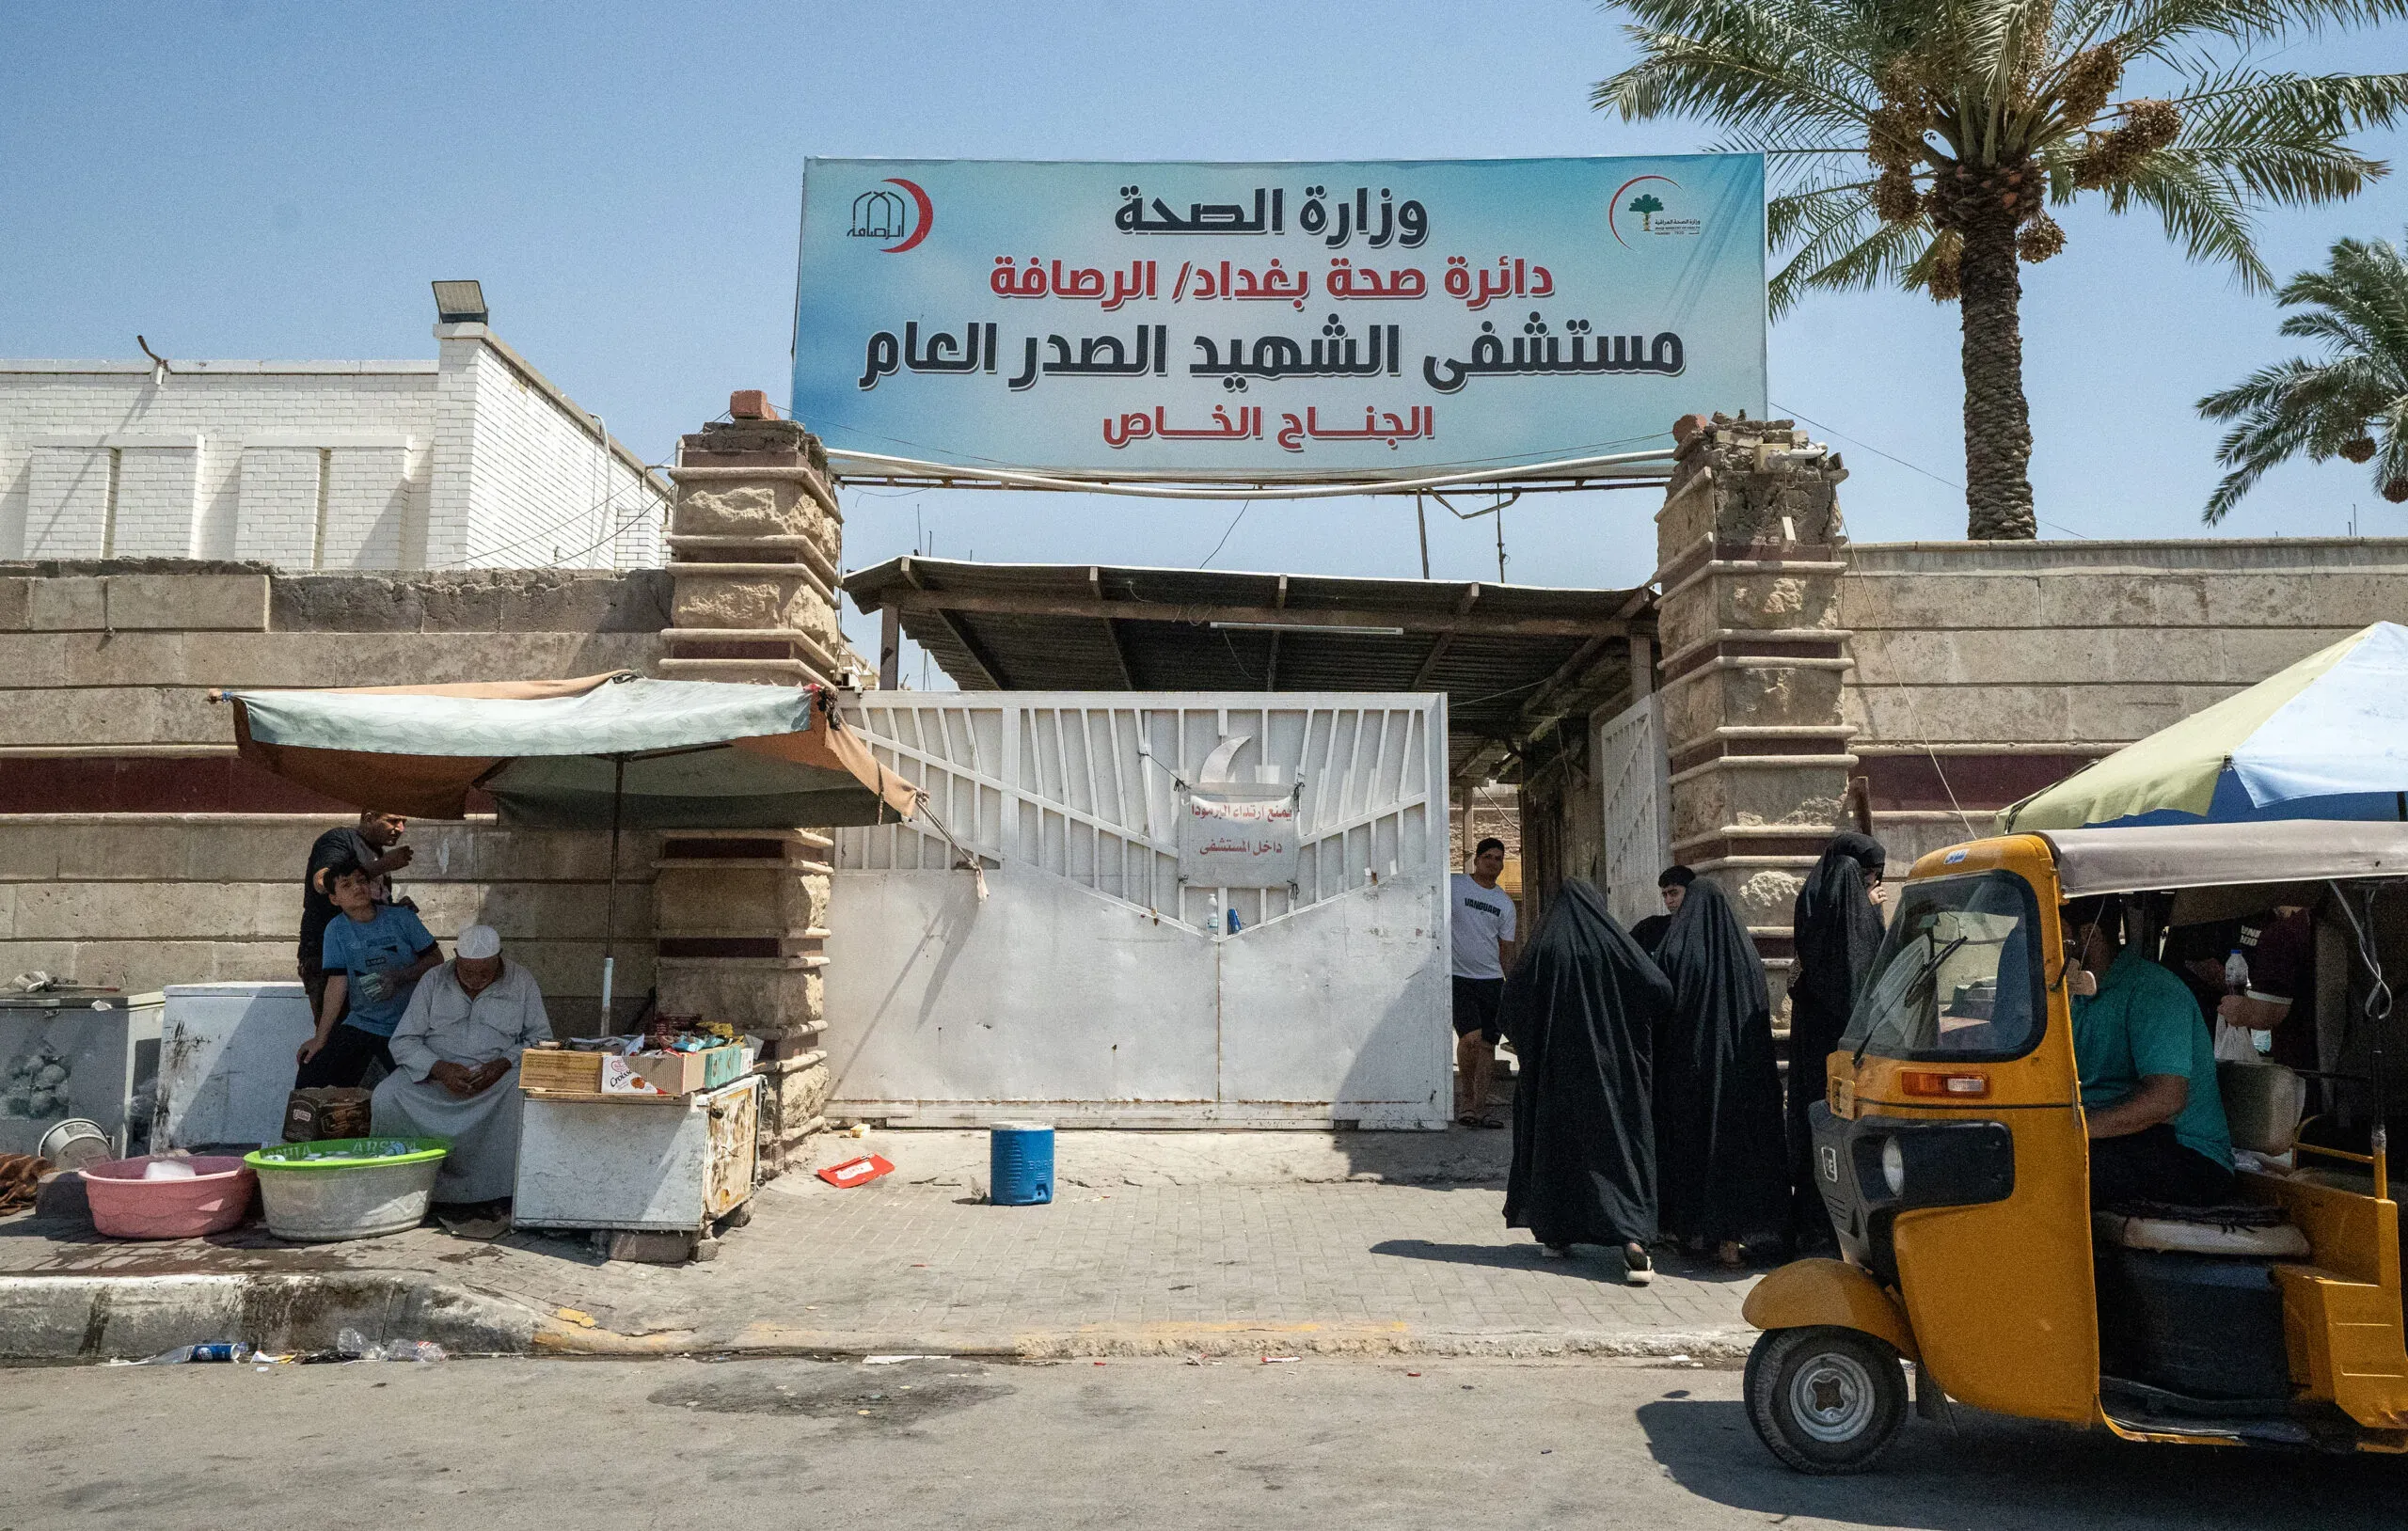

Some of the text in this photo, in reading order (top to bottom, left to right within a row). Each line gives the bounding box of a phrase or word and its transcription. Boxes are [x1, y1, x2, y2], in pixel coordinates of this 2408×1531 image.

[1116, 184, 1429, 248] وزارة الصحة
[990, 256, 1156, 310] الرصافة
[1326, 257, 1426, 299] صحة
[1445, 256, 1554, 309] دائرة
[858, 311, 1686, 392] مستشفى الشهيد الصدر العام
[1233, 804, 1265, 820] ارتداء
[1267, 806, 1293, 823] يمنع
[1199, 837, 1282, 856] داخل المستشفى
[1465, 898, 1501, 917] VANGUARD
